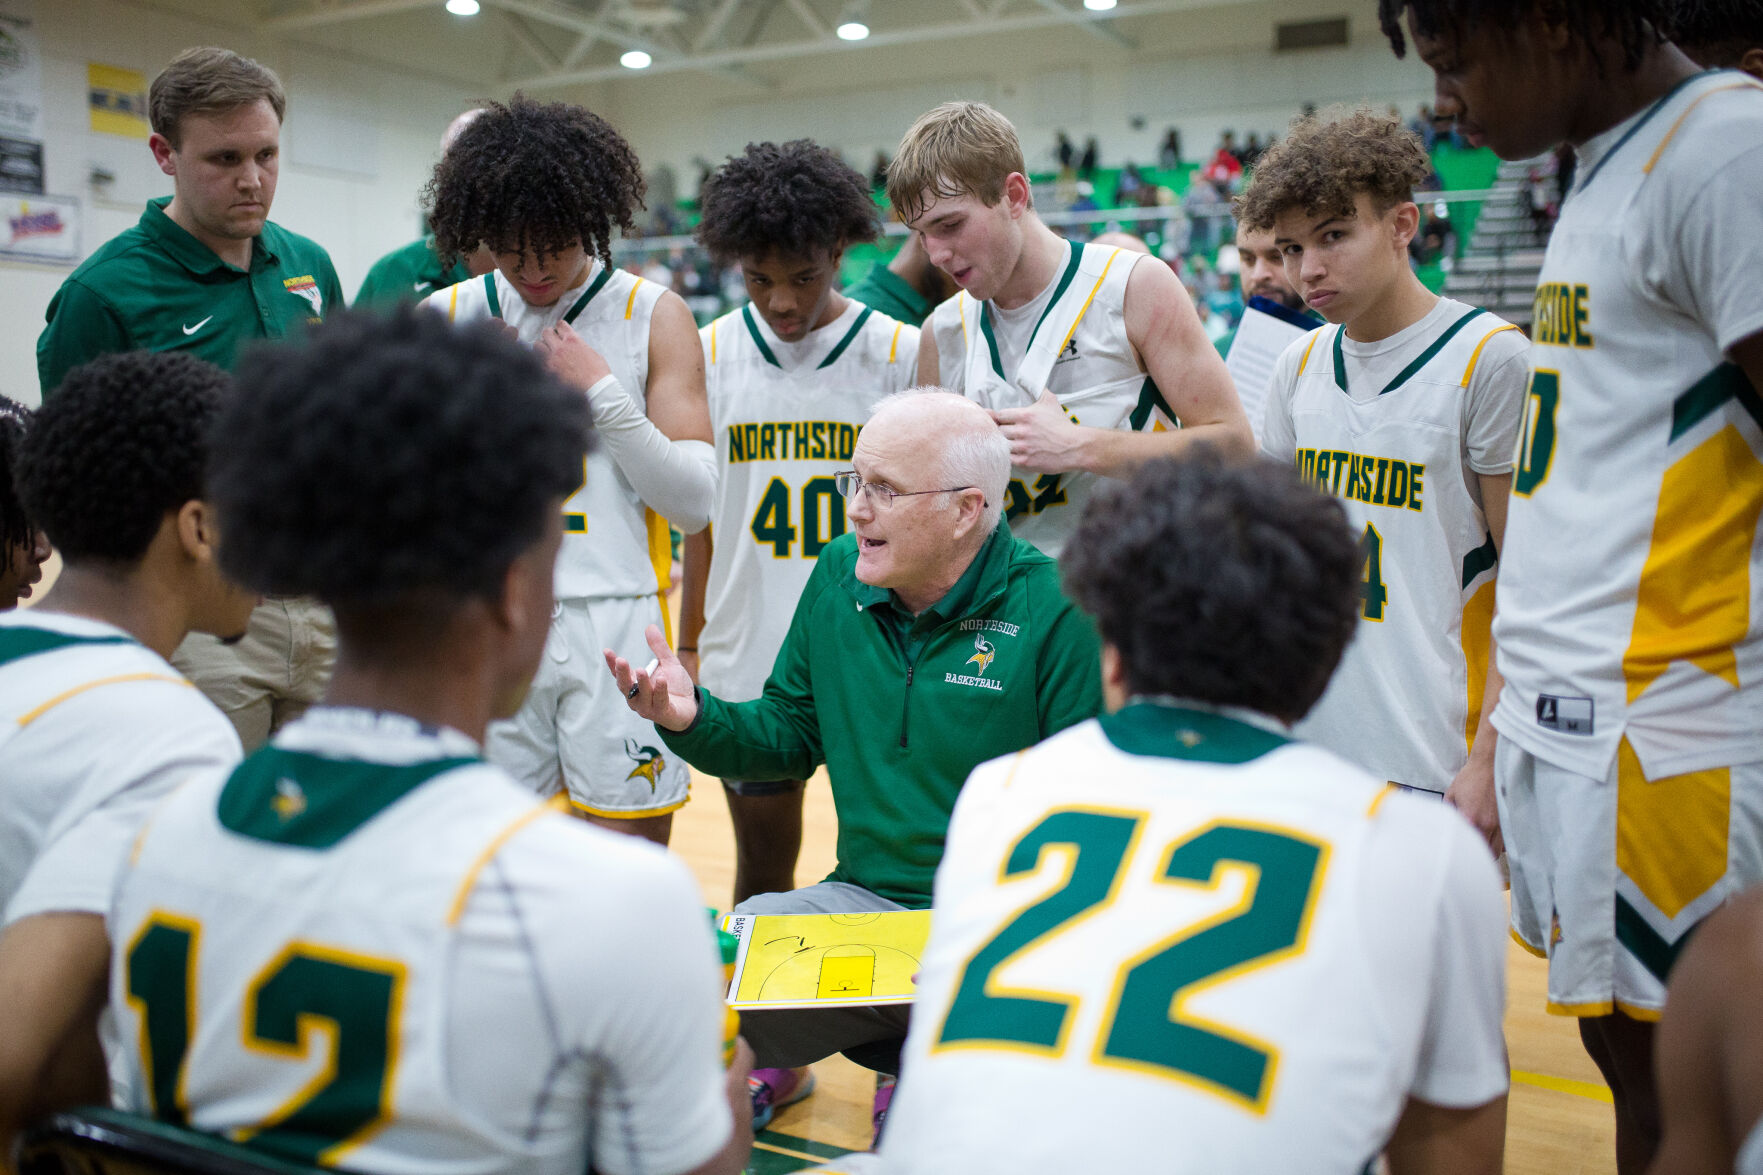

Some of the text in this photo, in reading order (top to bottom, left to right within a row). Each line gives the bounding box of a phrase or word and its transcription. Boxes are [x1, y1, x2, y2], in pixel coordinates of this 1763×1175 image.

[728, 421, 865, 464] NORTHSID
[750, 475, 848, 559] 40
[959, 619, 1021, 638] NORTHSIDE
[944, 671, 1003, 691] BASKETBALL
[732, 917, 747, 942] BASKE
[928, 803, 1333, 1120] 22
[124, 906, 410, 1169] 12
